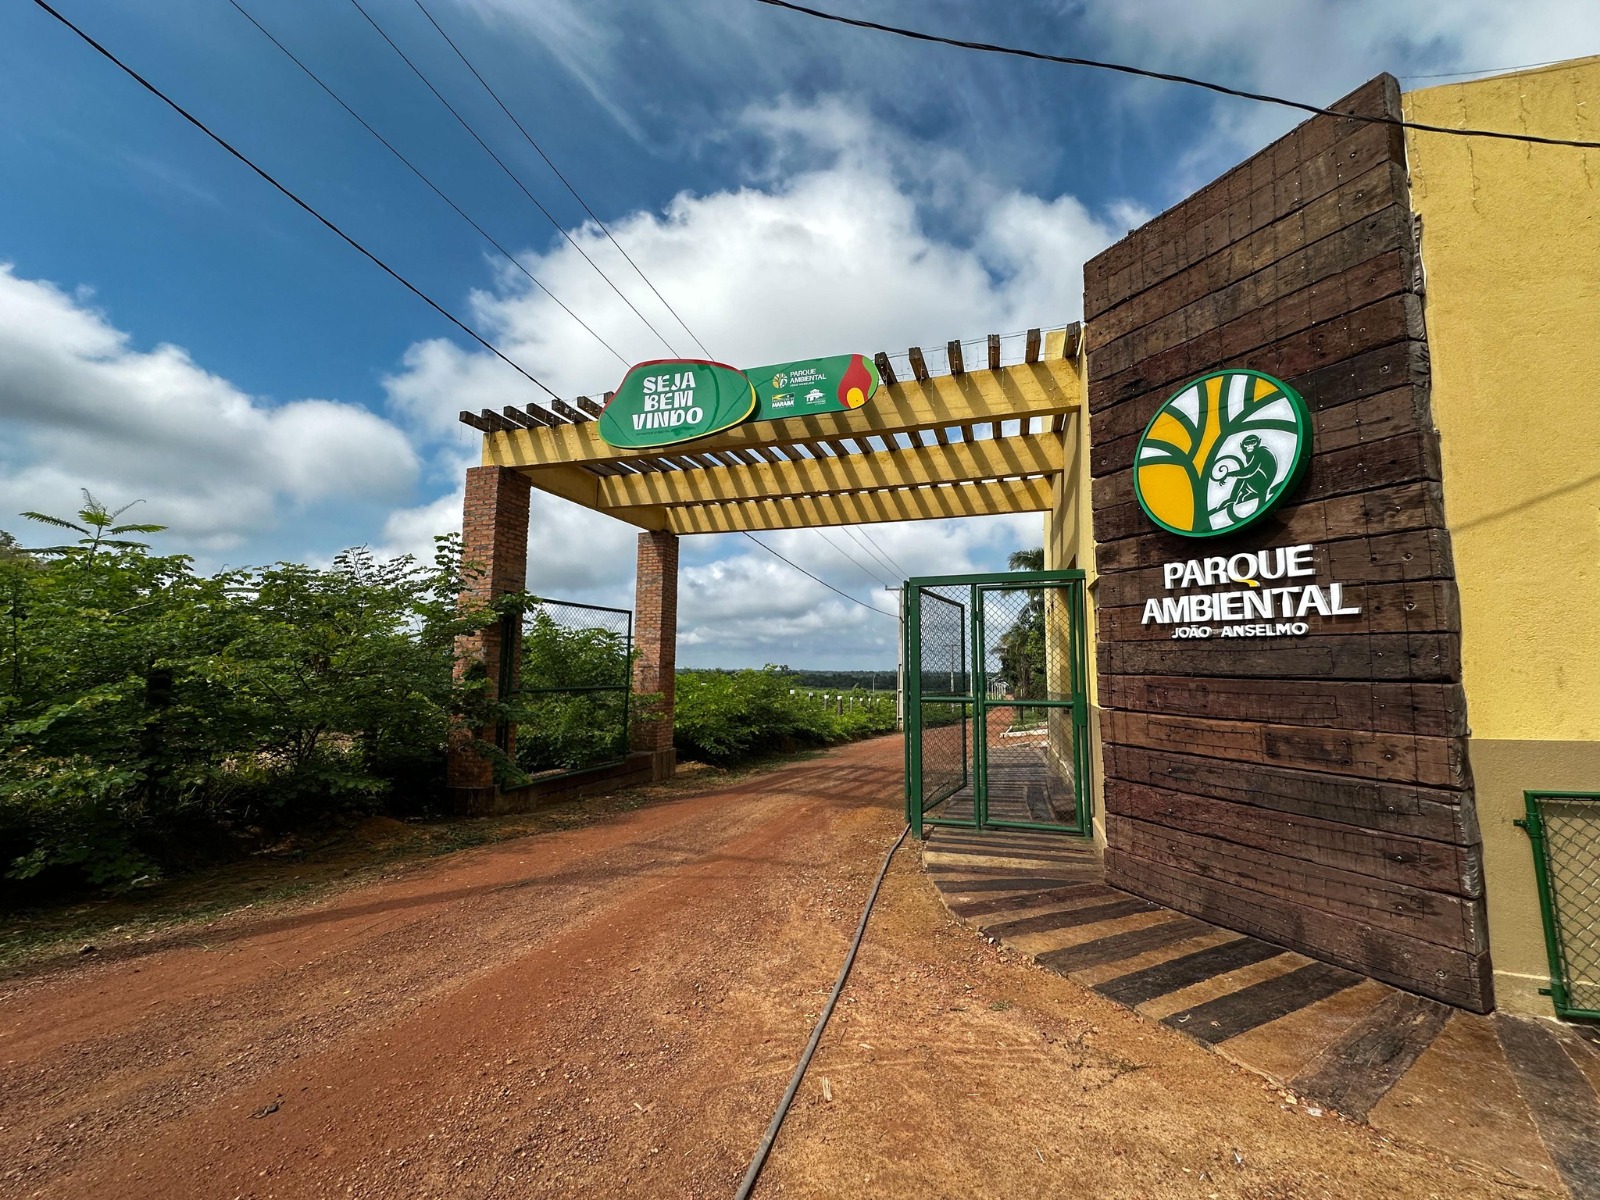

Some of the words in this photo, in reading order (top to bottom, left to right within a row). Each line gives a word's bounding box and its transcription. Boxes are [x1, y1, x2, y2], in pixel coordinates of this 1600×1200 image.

[643, 371, 695, 393] SEJA
[790, 368, 816, 378] PARQUE
[790, 373, 826, 383] AMBIENTAL
[644, 390, 693, 411] BEM
[632, 407, 703, 430] VINDO
[1163, 544, 1316, 589] PARQUE
[1141, 583, 1362, 624] AMBIENTAL
[1171, 624, 1212, 638] JOÃO
[1220, 622, 1309, 637] ANSELMO
